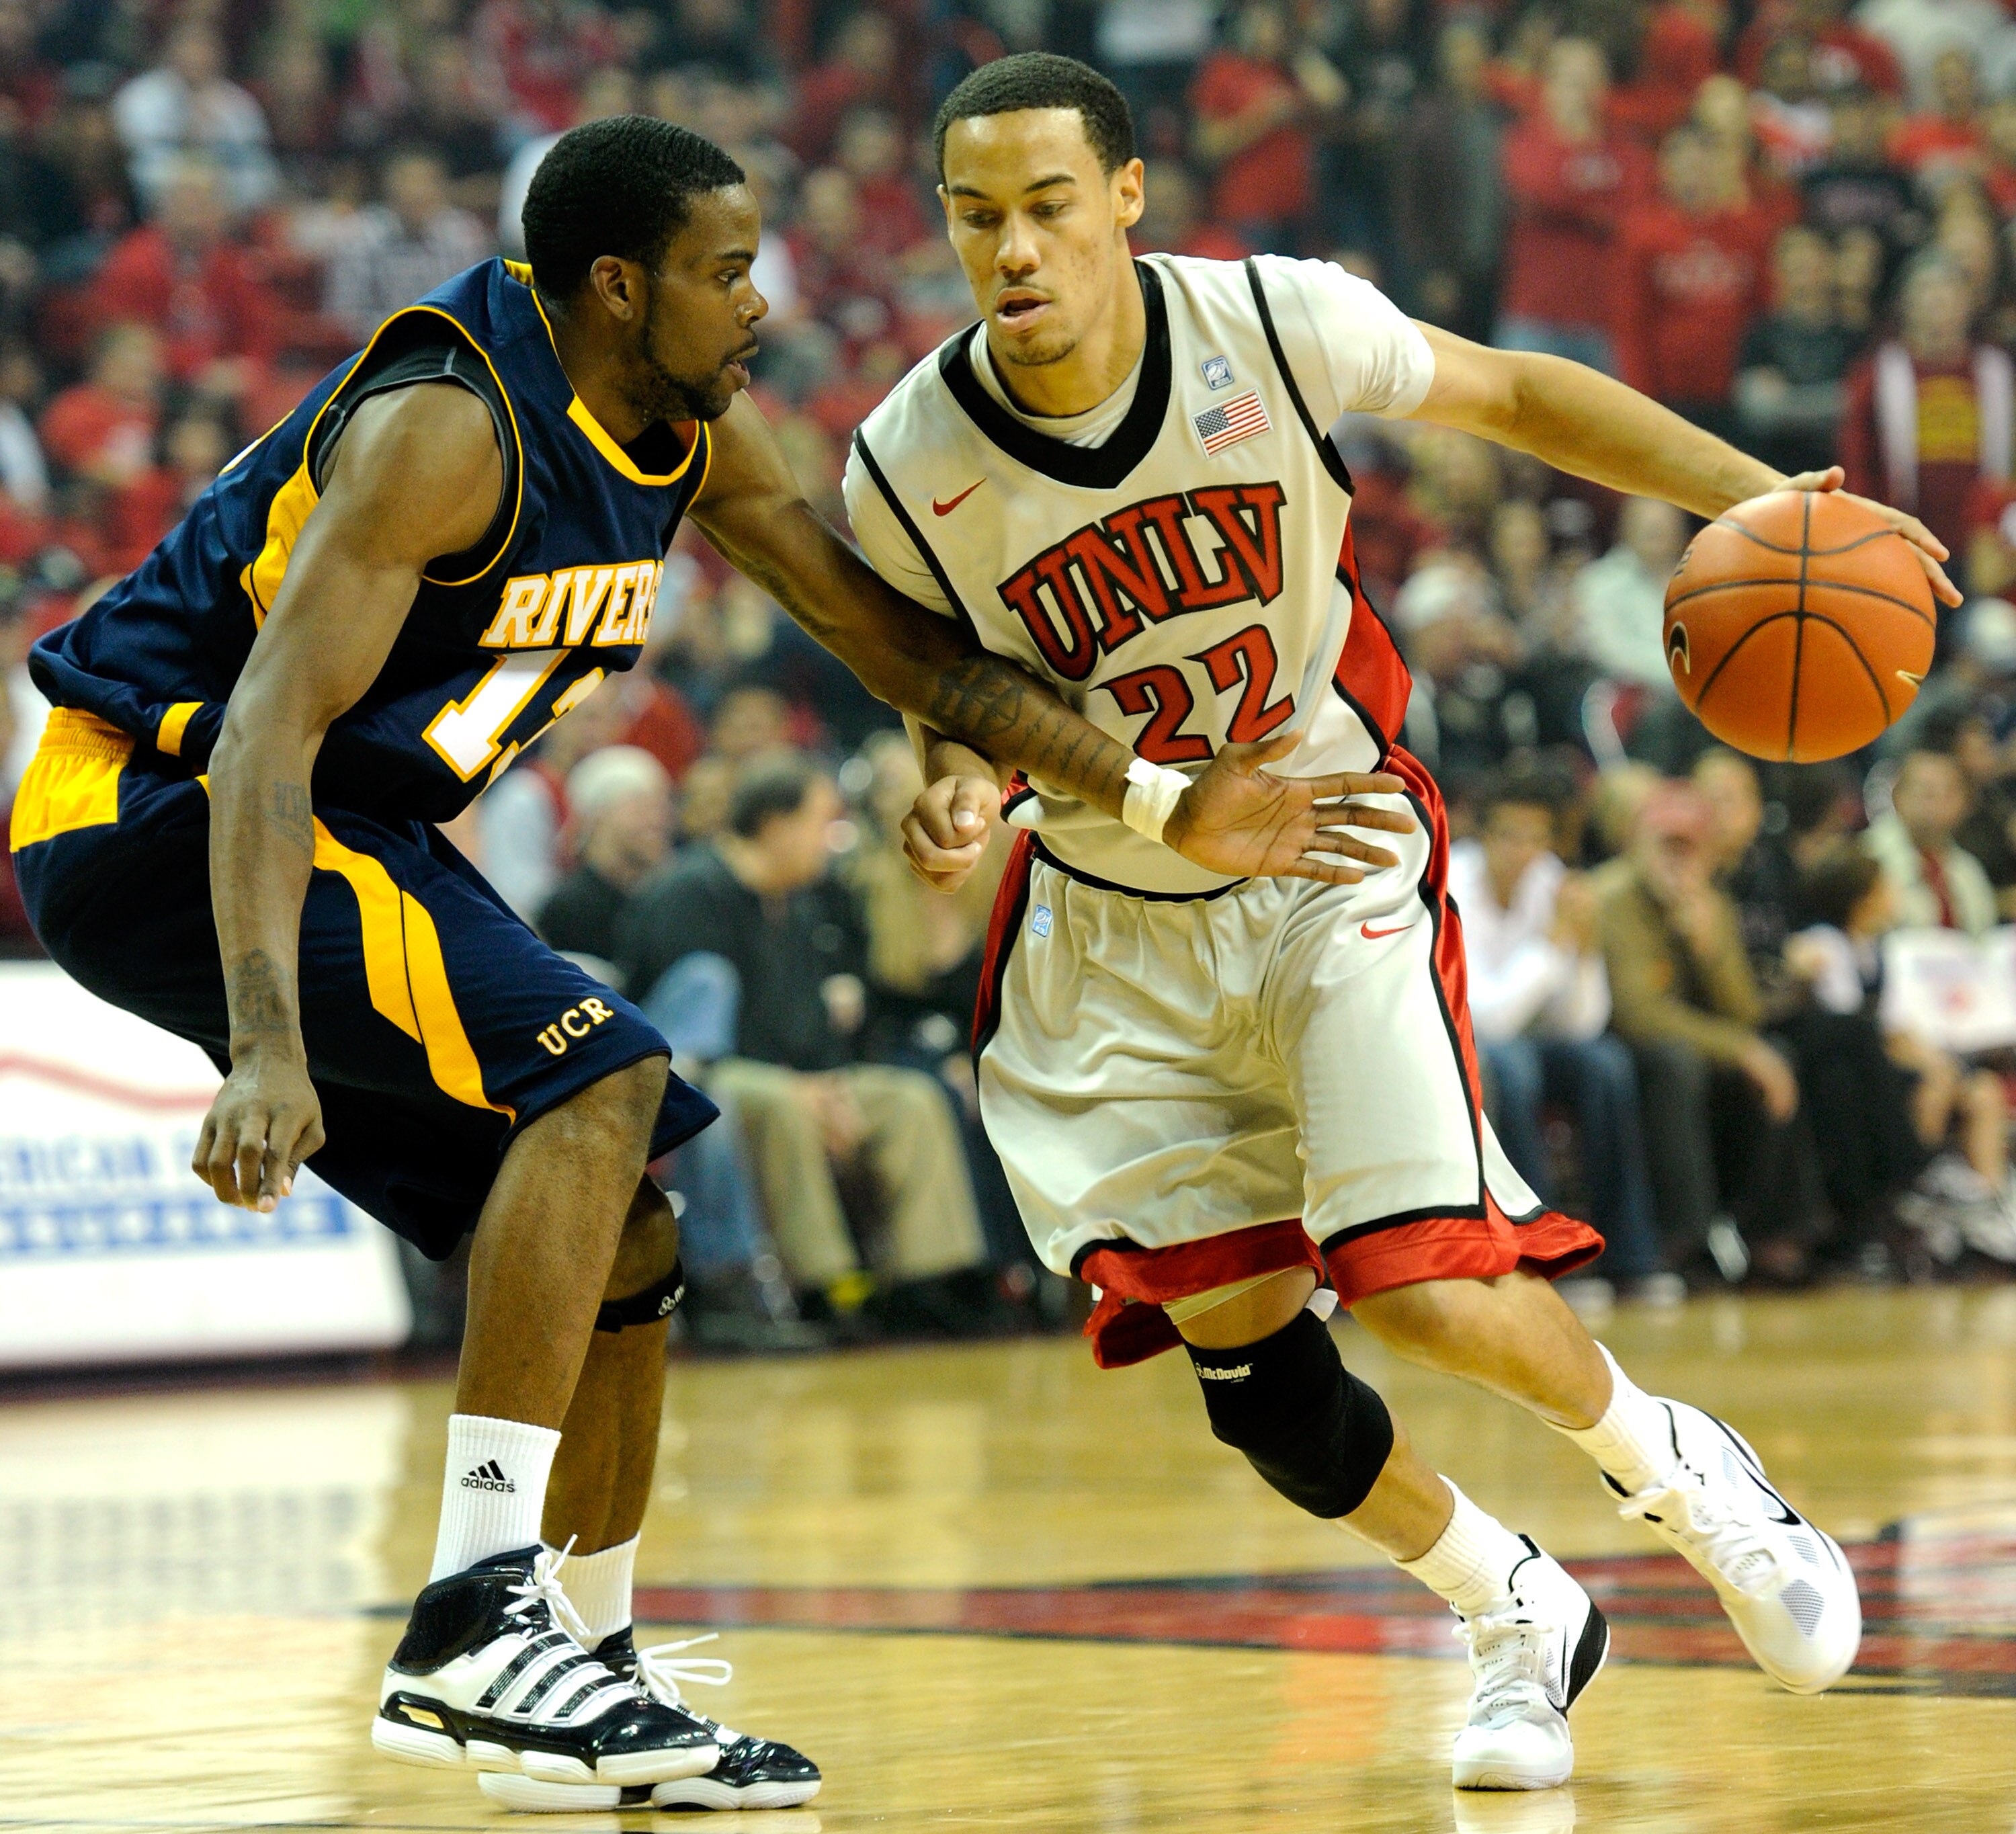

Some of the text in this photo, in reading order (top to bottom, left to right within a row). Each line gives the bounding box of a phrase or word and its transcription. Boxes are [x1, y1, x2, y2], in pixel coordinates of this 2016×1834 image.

[996, 481, 1288, 681] UNLV
[1087, 624, 1296, 765] 22
[536, 997, 614, 1056] UCR
[1202, 1364, 1251, 1380] McDavid
[461, 1475, 515, 1493] adidas
